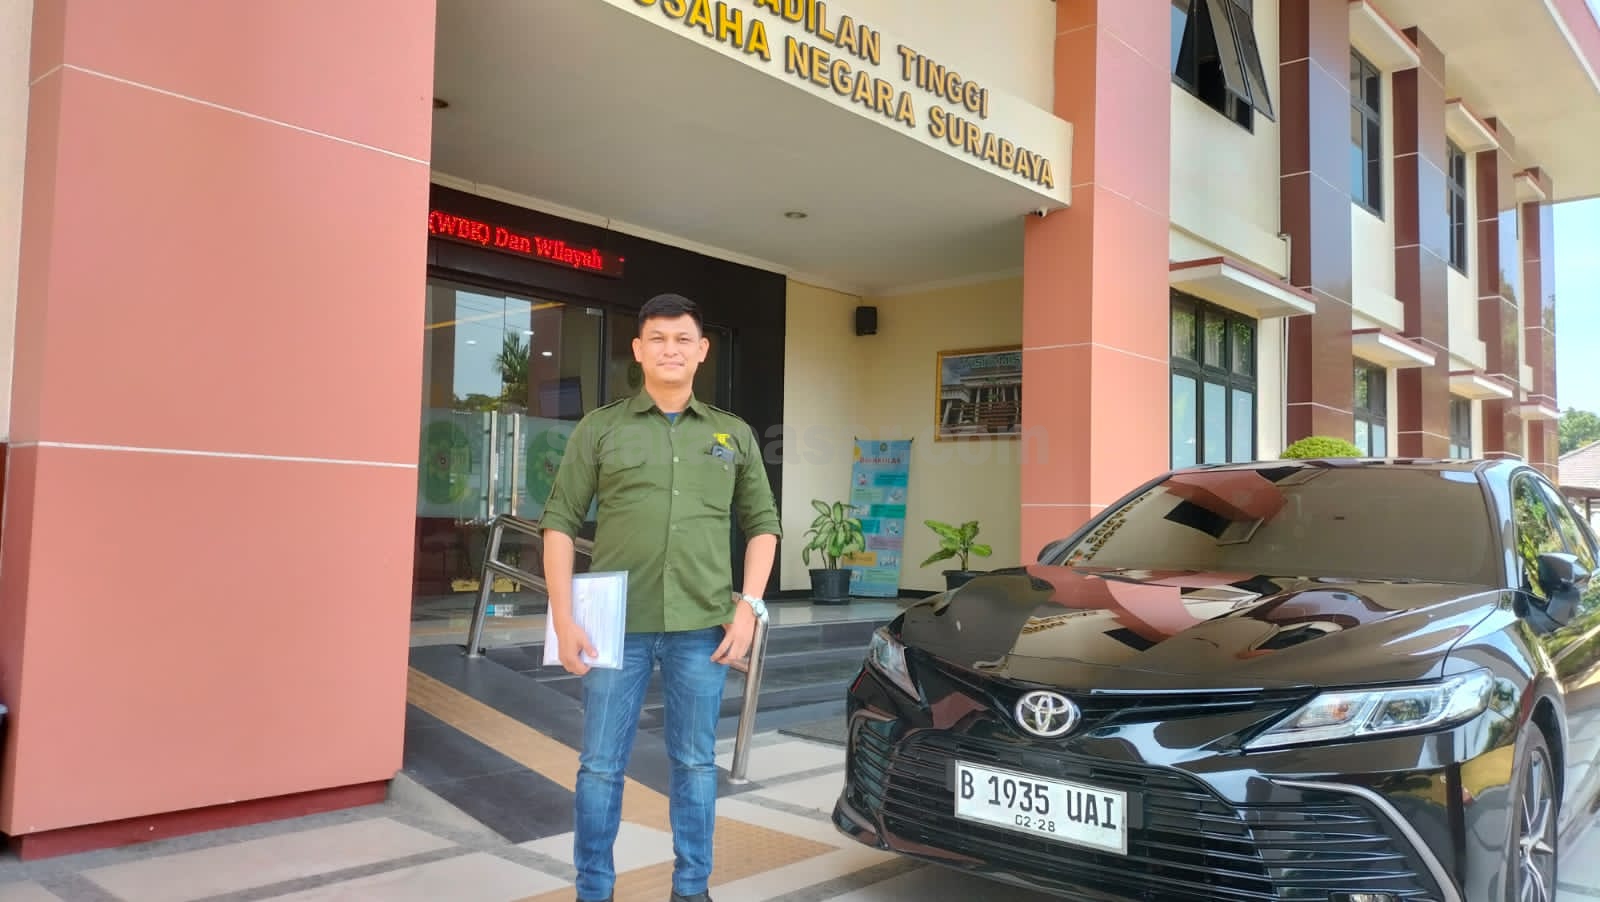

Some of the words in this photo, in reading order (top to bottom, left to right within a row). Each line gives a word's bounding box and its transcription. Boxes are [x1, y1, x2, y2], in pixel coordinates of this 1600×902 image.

[785, 36, 916, 127] NEGARA
[928, 105, 1055, 189] SURABAYA
[898, 44, 990, 119] TINGGI
[494, 226, 531, 253] Dan
[961, 769, 974, 800] B
[987, 775, 1049, 815] 1935
[1066, 789, 1116, 830] UAI
